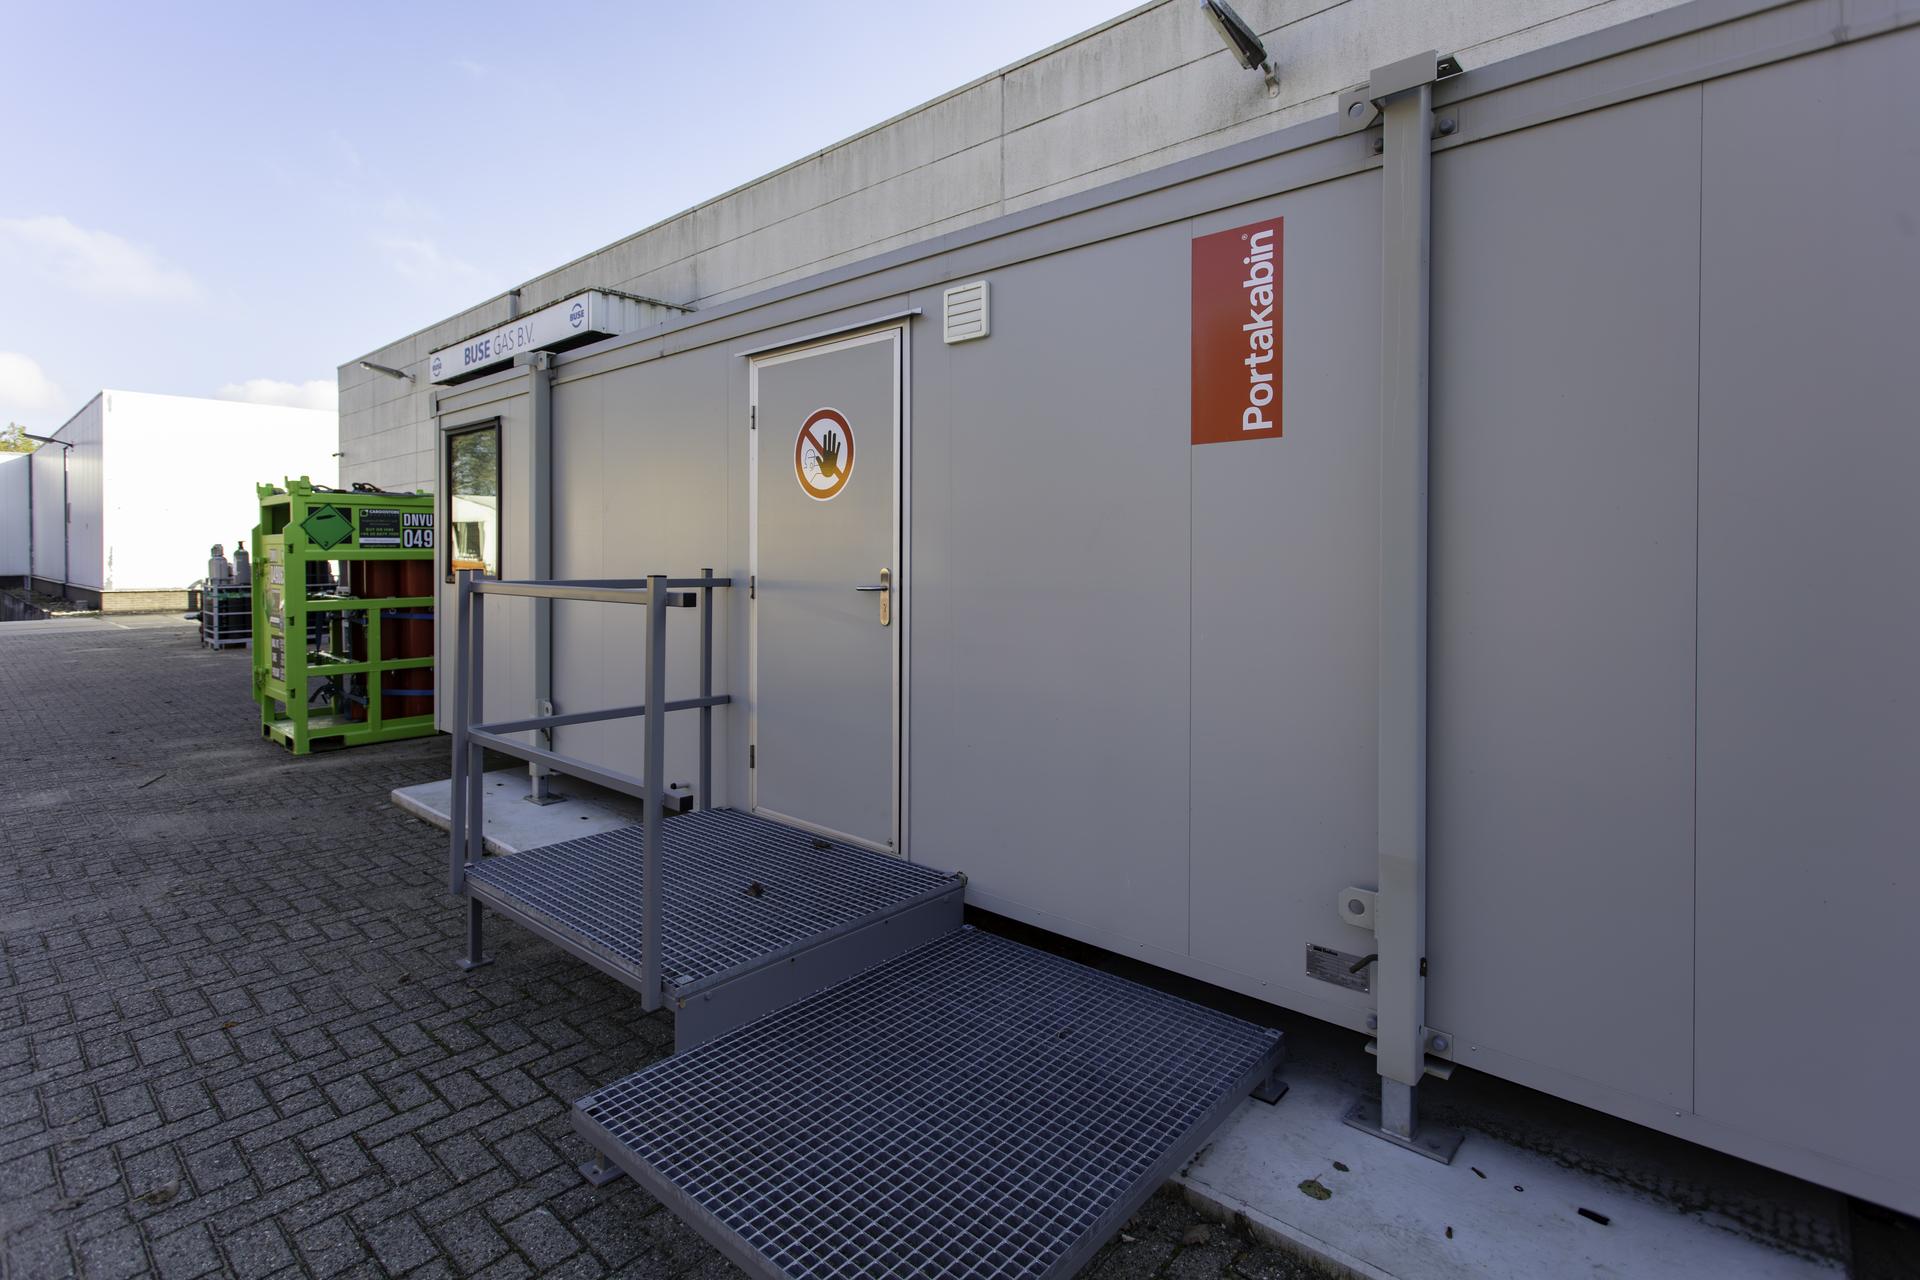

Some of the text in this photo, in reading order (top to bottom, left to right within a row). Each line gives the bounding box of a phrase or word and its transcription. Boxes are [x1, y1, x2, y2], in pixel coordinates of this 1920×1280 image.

[569, 309, 585, 322] BUSE
[464, 322, 535, 366] BUSE GAS B.V.
[403, 513, 433, 527] DNVU
[403, 529, 433, 548] 049
